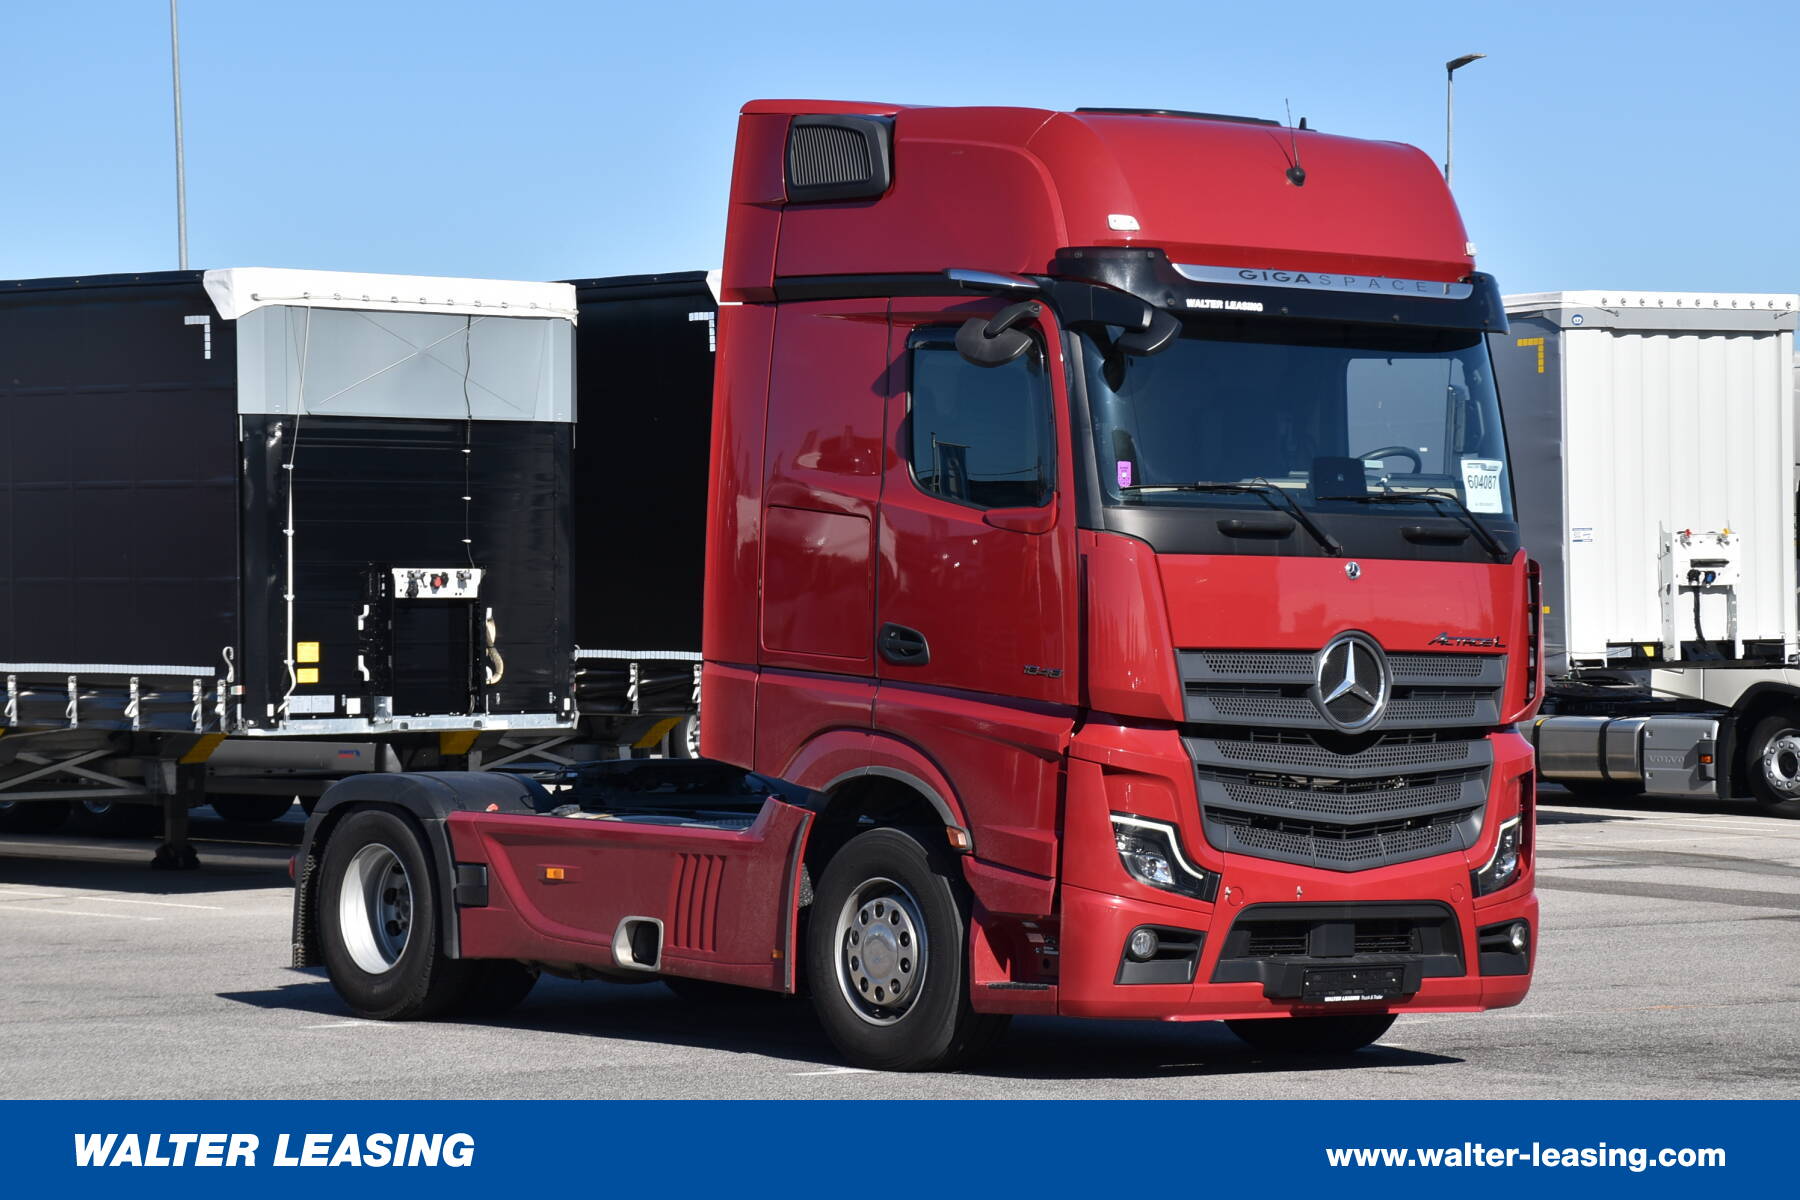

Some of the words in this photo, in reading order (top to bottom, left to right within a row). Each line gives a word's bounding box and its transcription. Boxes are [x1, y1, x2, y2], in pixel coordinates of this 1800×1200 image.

[1239, 269, 1427, 293] GIGASPACE
[1186, 298, 1223, 309] WALTER
[1225, 300, 1263, 312] LEASING
[1466, 474, 1497, 490] 604087
